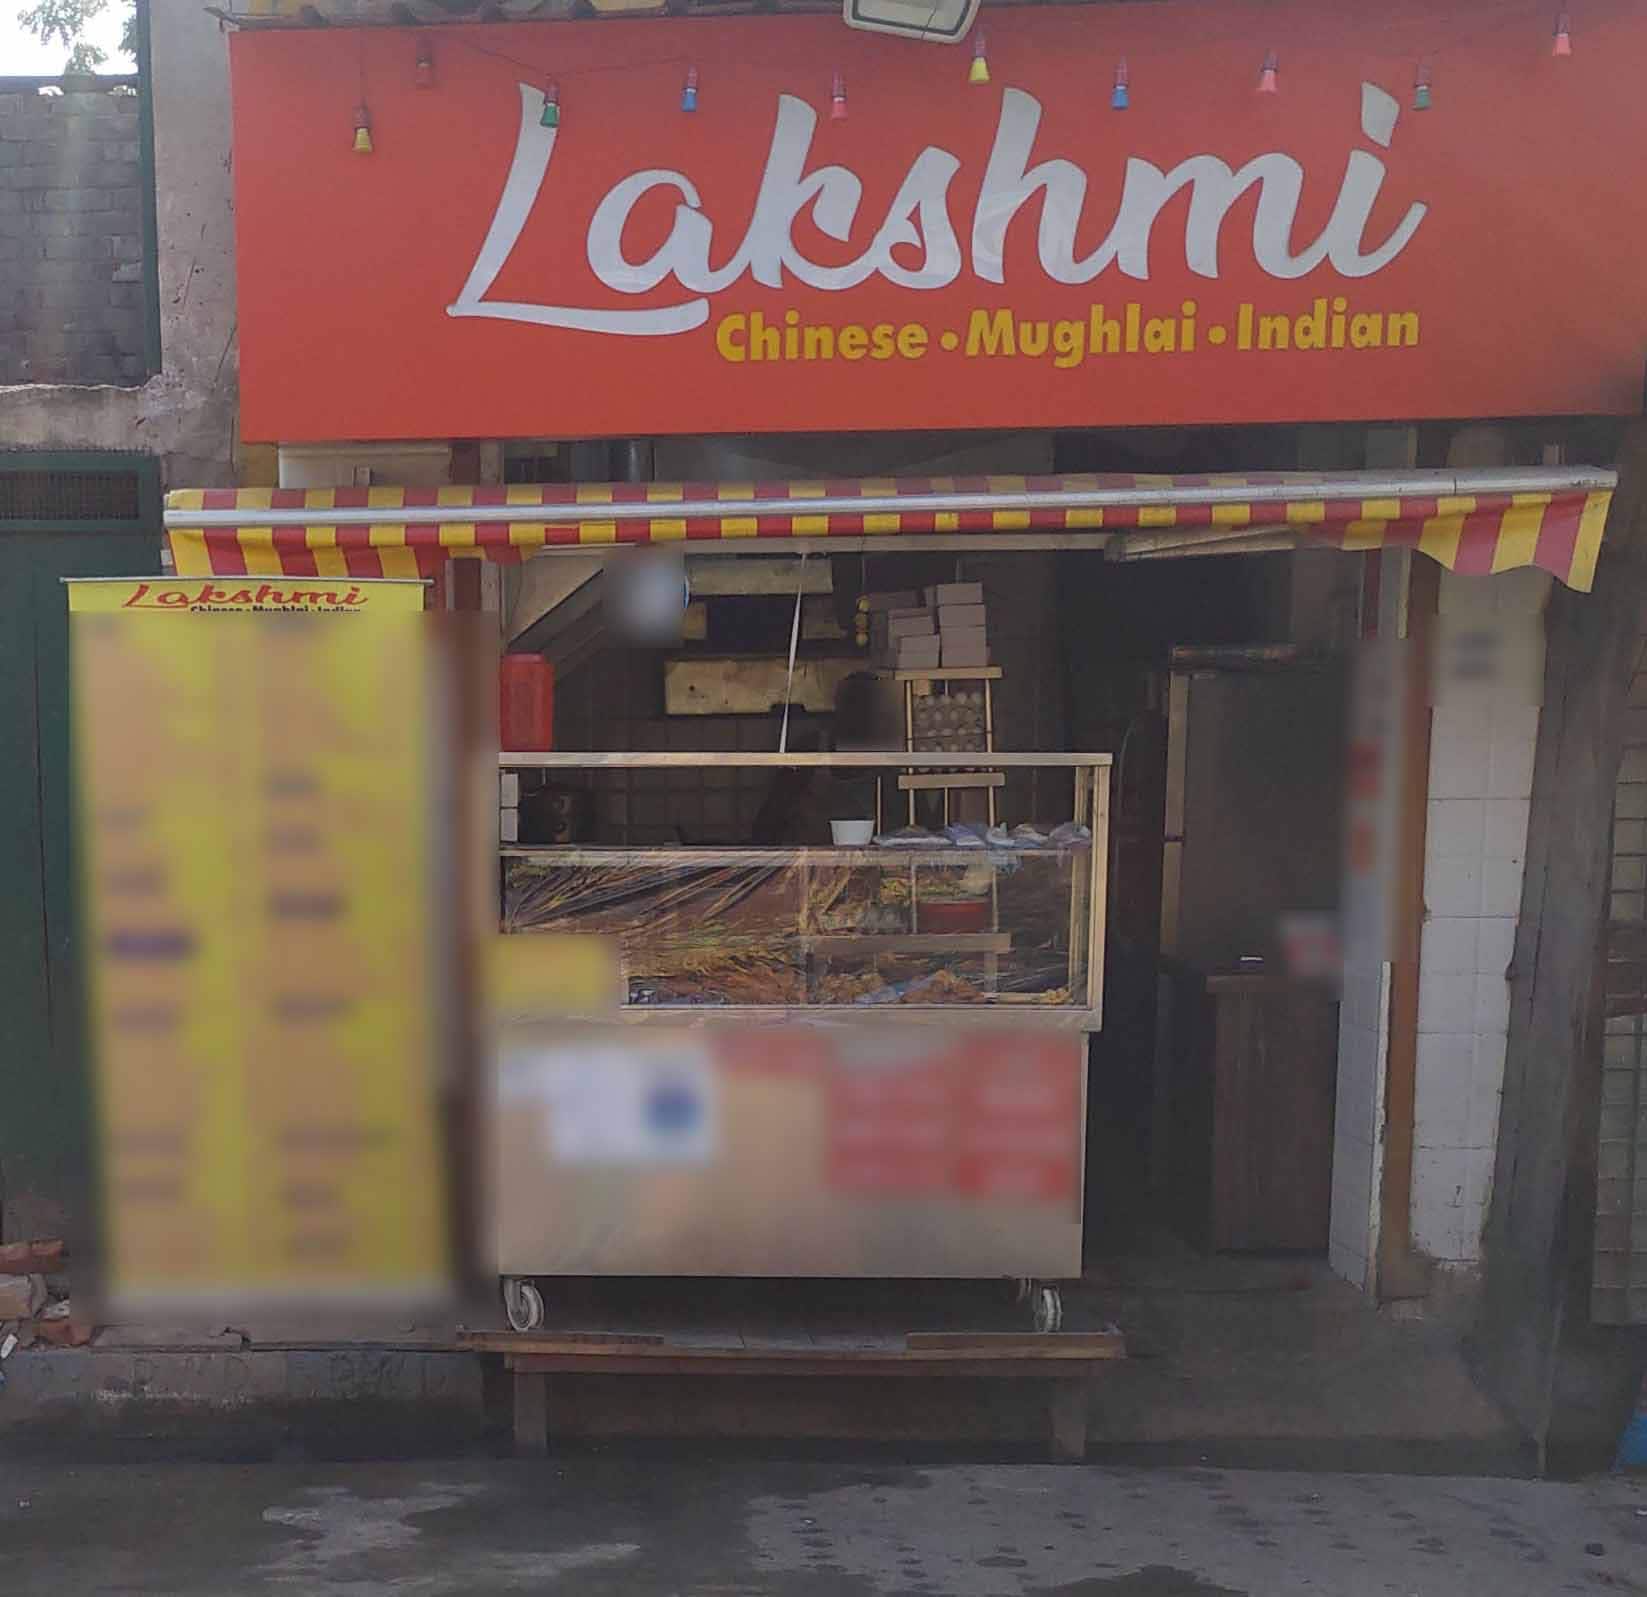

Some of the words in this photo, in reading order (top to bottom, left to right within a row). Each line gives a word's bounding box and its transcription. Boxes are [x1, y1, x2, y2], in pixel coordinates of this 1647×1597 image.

[446, 81, 1428, 335] Lakshmi
[716, 309, 929, 362] Chinese
[965, 299, 1197, 369] Mughlai
[1236, 297, 1420, 350] Indian
[121, 583, 369, 608] Lakshmi
